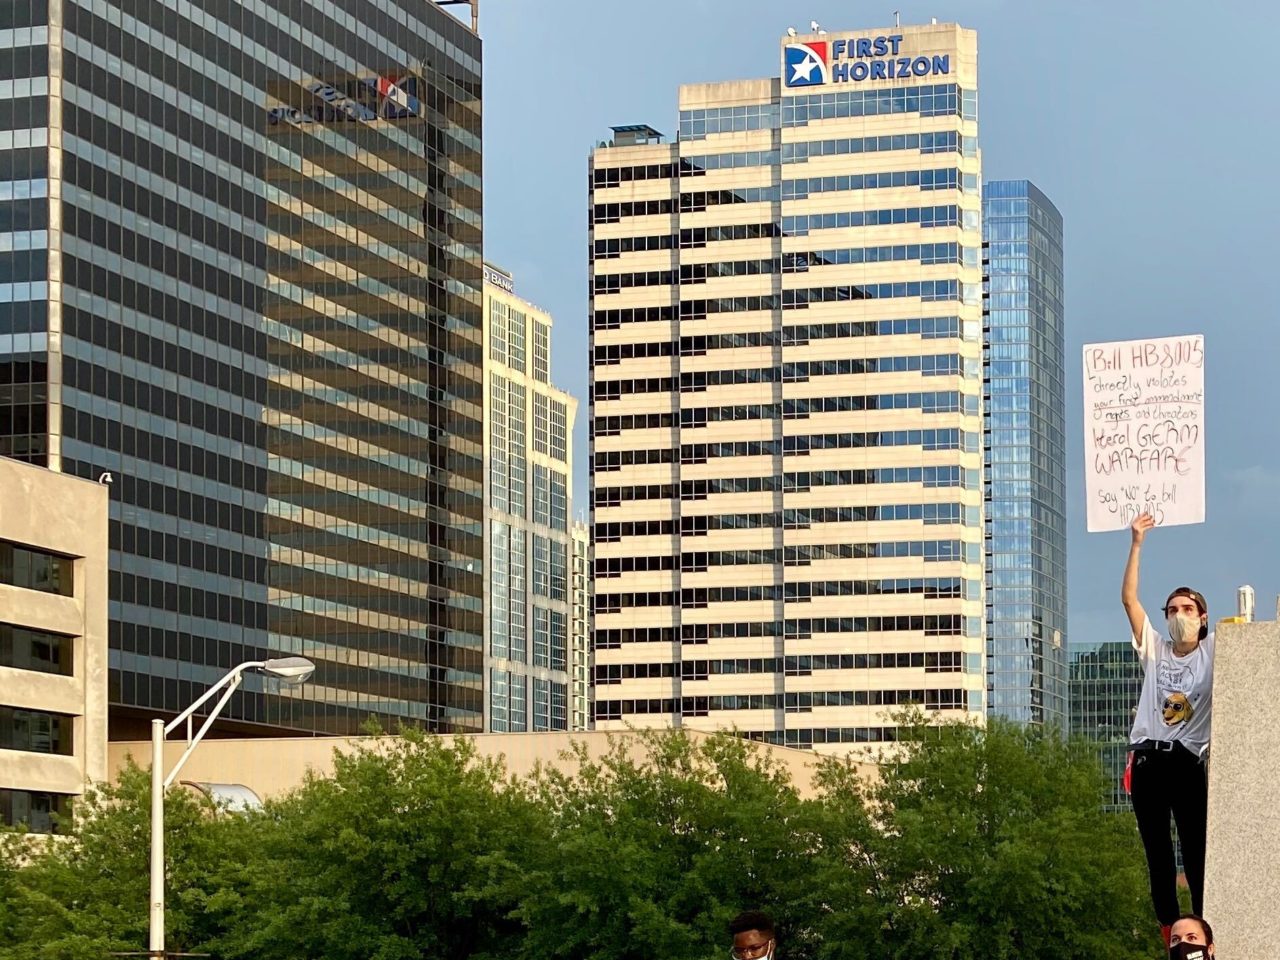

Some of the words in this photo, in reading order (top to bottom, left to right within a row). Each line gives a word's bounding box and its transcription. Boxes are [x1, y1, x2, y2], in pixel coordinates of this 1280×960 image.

[832, 35, 903, 60] FIRST
[832, 54, 950, 83] HORIZON
[491, 272, 513, 293] BANK
[1094, 374, 1141, 397] directly
[1146, 368, 1187, 388] violates
[1094, 399, 1113, 420] your
[1118, 393, 1139, 407] first
[1137, 419, 1198, 447] GERM
[1095, 446, 1192, 476] WARFARE
[1144, 484, 1157, 502] to
